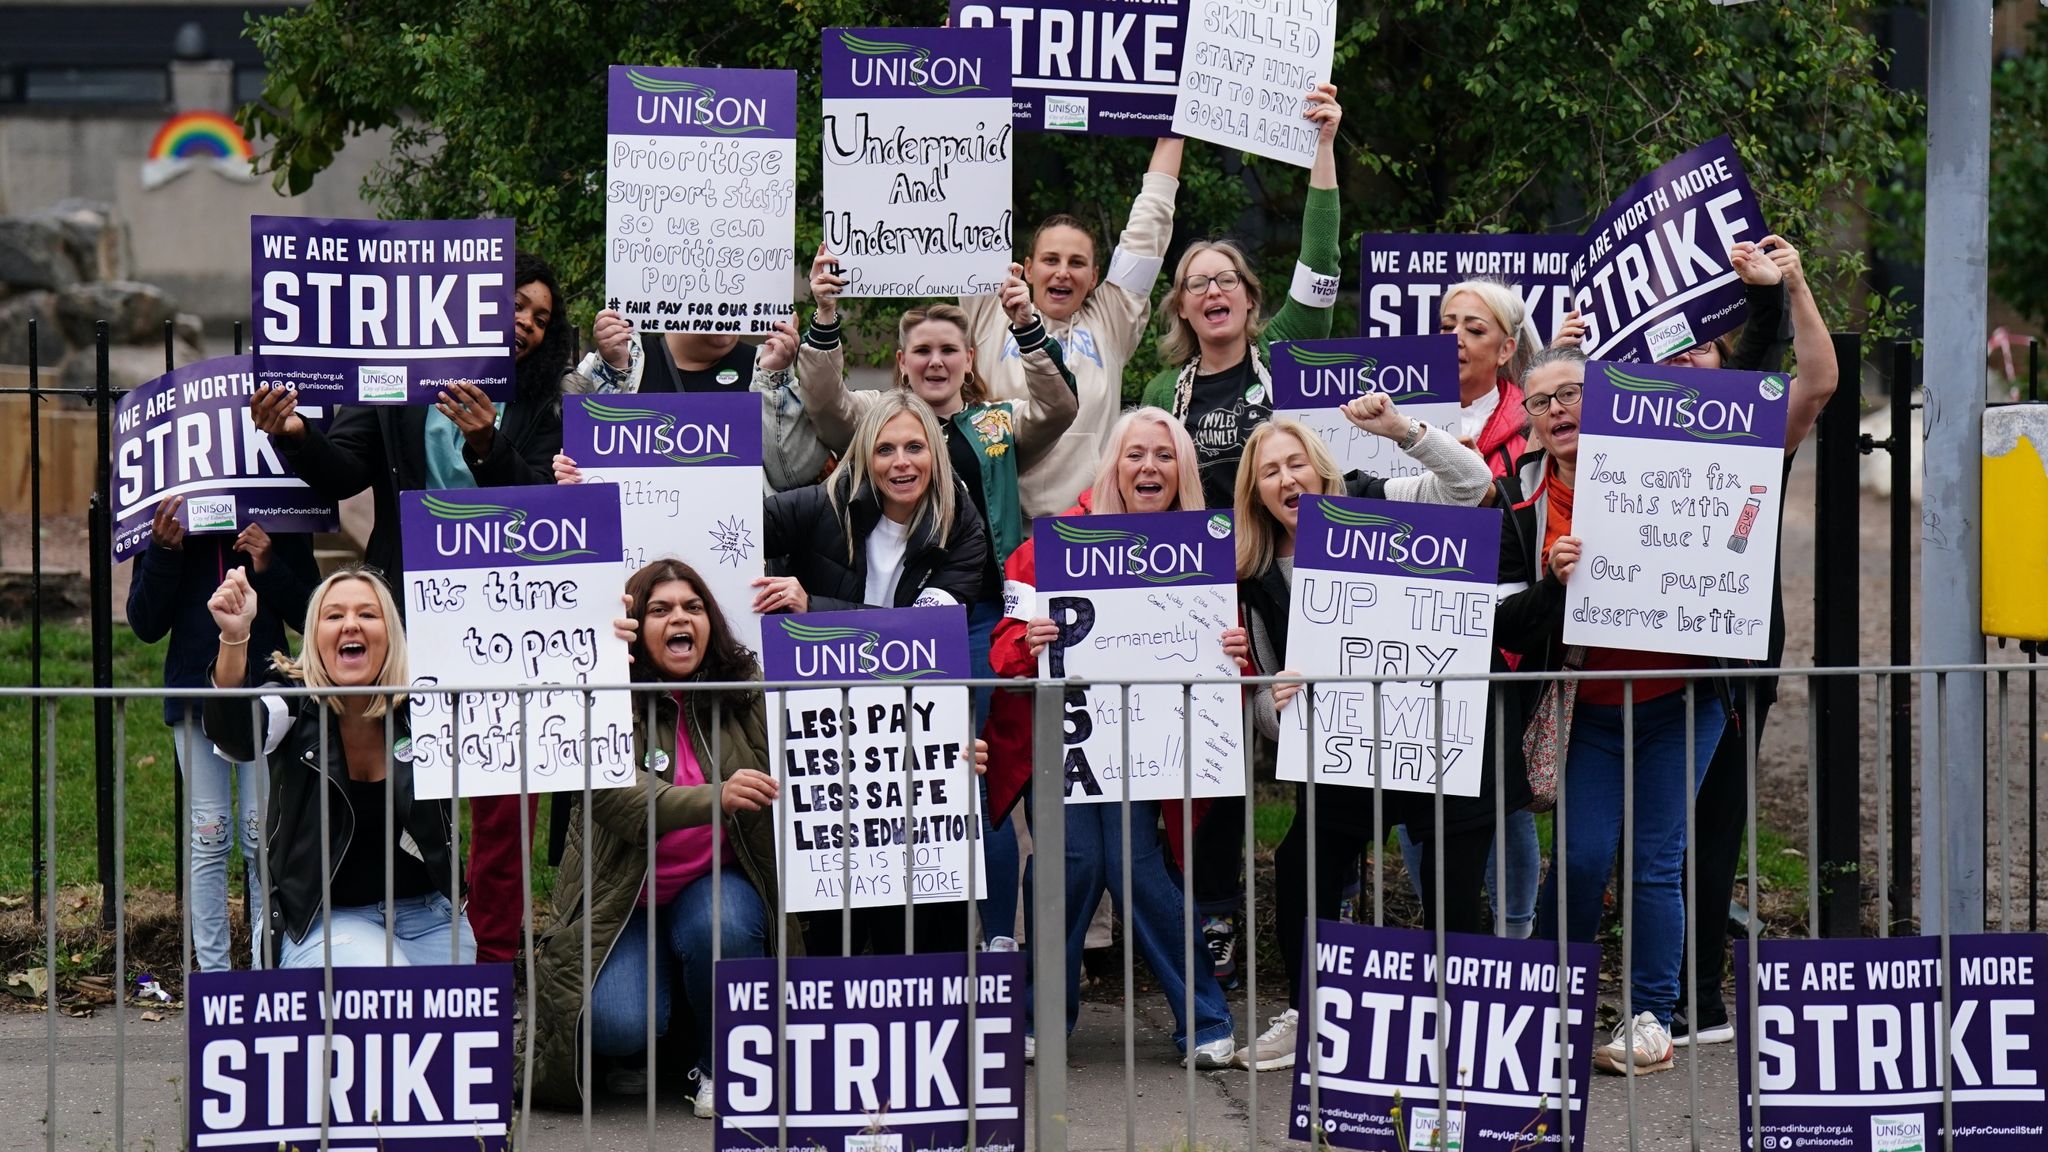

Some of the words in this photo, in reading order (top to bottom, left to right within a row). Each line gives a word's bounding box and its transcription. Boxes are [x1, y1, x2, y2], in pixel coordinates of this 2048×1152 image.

[1204, 2, 1320, 58] SKILLED
[852, 57, 982, 87] UNISON
[1196, 42, 1255, 76] STAFF
[1263, 58, 1316, 92] HUNG
[636, 96, 766, 126] UNISON
[1049, 103, 1085, 114] UNISON
[1187, 71, 1222, 96] OUT
[1228, 81, 1254, 106] TO
[1259, 89, 1297, 116] DRY
[613, 139, 783, 176] Prioritise
[823, 113, 1011, 179] Underpaid
[723, 178, 794, 217] staff
[888, 167, 946, 205] And
[667, 216, 700, 236] we
[711, 218, 764, 238] can
[824, 210, 1012, 256] Undervalued
[1570, 254, 1587, 287] WE
[1589, 228, 1612, 268] ARE
[1613, 186, 1670, 241] WORTH
[1671, 156, 1733, 202] MORE
[262, 234, 297, 260] WE
[305, 237, 348, 262] ARE
[358, 239, 434, 263] WORTH
[444, 238, 503, 262] MORE
[747, 247, 793, 271] our
[1370, 251, 1400, 273] WE
[1407, 251, 1447, 273] ARE
[1456, 252, 1525, 274] WORTH
[1574, 188, 1750, 351] STRIKE
[263, 270, 504, 346] STRIKE
[625, 300, 650, 314] FAIR
[657, 300, 682, 315] PAY
[688, 302, 713, 316] FOR
[718, 302, 748, 317] OUR
[753, 302, 794, 316] SKILLS
[641, 319, 659, 330] WE
[664, 319, 690, 331] CAN
[692, 320, 714, 332] PAY
[715, 320, 741, 332] OUR
[1650, 321, 1687, 345] UNISON
[259, 370, 344, 381] unison-edinburgh.org.uk
[298, 382, 344, 391] @unisonedin
[362, 374, 404, 384] UNISON
[1300, 364, 1429, 397] UNISON
[119, 404, 141, 434] WE
[145, 388, 177, 421] ARE
[182, 372, 255, 404] WORTH
[1203, 412, 1236, 429] MYLES
[1612, 393, 1754, 433] UNISON
[593, 424, 730, 455] UNISON
[1199, 426, 1239, 446] MANLEY
[119, 406, 323, 506] STRIK
[1590, 453, 1627, 485] You
[1641, 467, 1691, 489] can't
[1706, 462, 1742, 491] fix
[191, 503, 233, 515] UNISON
[248, 507, 331, 516] #PayUpForCouncilStaff
[587, 476, 681, 517] tting
[1605, 491, 1659, 515] this
[1672, 496, 1729, 518] with
[436, 518, 586, 556] UNISON
[1325, 527, 1467, 567] UNISON
[1065, 542, 1203, 577] UNISON
[1591, 555, 1641, 582] Our
[1661, 571, 1750, 597] pupils
[414, 578, 467, 612] It's
[483, 571, 578, 611] time
[1302, 579, 1377, 625] UP
[1405, 587, 1489, 637] THE
[1573, 597, 1668, 629] deserve
[1678, 606, 1763, 636] better
[463, 627, 512, 665] to
[521, 627, 597, 678] pay
[795, 638, 936, 677] UNISON
[1341, 637, 1457, 688] PAY
[785, 705, 858, 740] LESS
[867, 701, 935, 734] PAY
[1295, 688, 1364, 735] WE
[1381, 694, 1473, 745] WILL
[413, 721, 527, 772] staff
[534, 715, 634, 783] fairly
[786, 747, 856, 777] LESS
[864, 743, 960, 773] STAFF
[1323, 736, 1463, 785] STAY
[791, 782, 859, 813] LESS
[866, 778, 948, 809] SAFE
[794, 820, 859, 850] LESS
[809, 851, 859, 873] LESS
[870, 850, 888, 868] IS
[903, 847, 944, 868] NOT
[903, 870, 963, 893] MORE
[1316, 942, 1354, 976] WE
[1363, 948, 1414, 981] ARE
[1423, 953, 1511, 990] WORTH
[1750, 962, 1790, 991] WE
[1801, 962, 1855, 991] ARE
[1960, 956, 2034, 986] MORE
[202, 994, 245, 1026] WE
[254, 991, 307, 1024] ARE
[319, 989, 413, 1020] WORTH
[424, 987, 499, 1018] MORE
[728, 981, 769, 1011] WE
[785, 980, 833, 1010] ARE
[844, 977, 933, 1009] WORTH
[943, 974, 1012, 1006] MORE
[1307, 986, 1583, 1095] STRIKE
[1758, 1000, 2037, 1091] STRIKE
[202, 1030, 499, 1130] STRIKE
[727, 1017, 1012, 1112] STRIKE
[1339, 1122, 1395, 1136] @unisonedin
[1747, 1124, 1853, 1135] uson-edinburgh.org.uk
[1796, 1137, 1853, 1147] @unisonedin
[1876, 1124, 1920, 1137] UNISON
[1937, 1126, 2043, 1137] #ayUpForCouncilStaff
